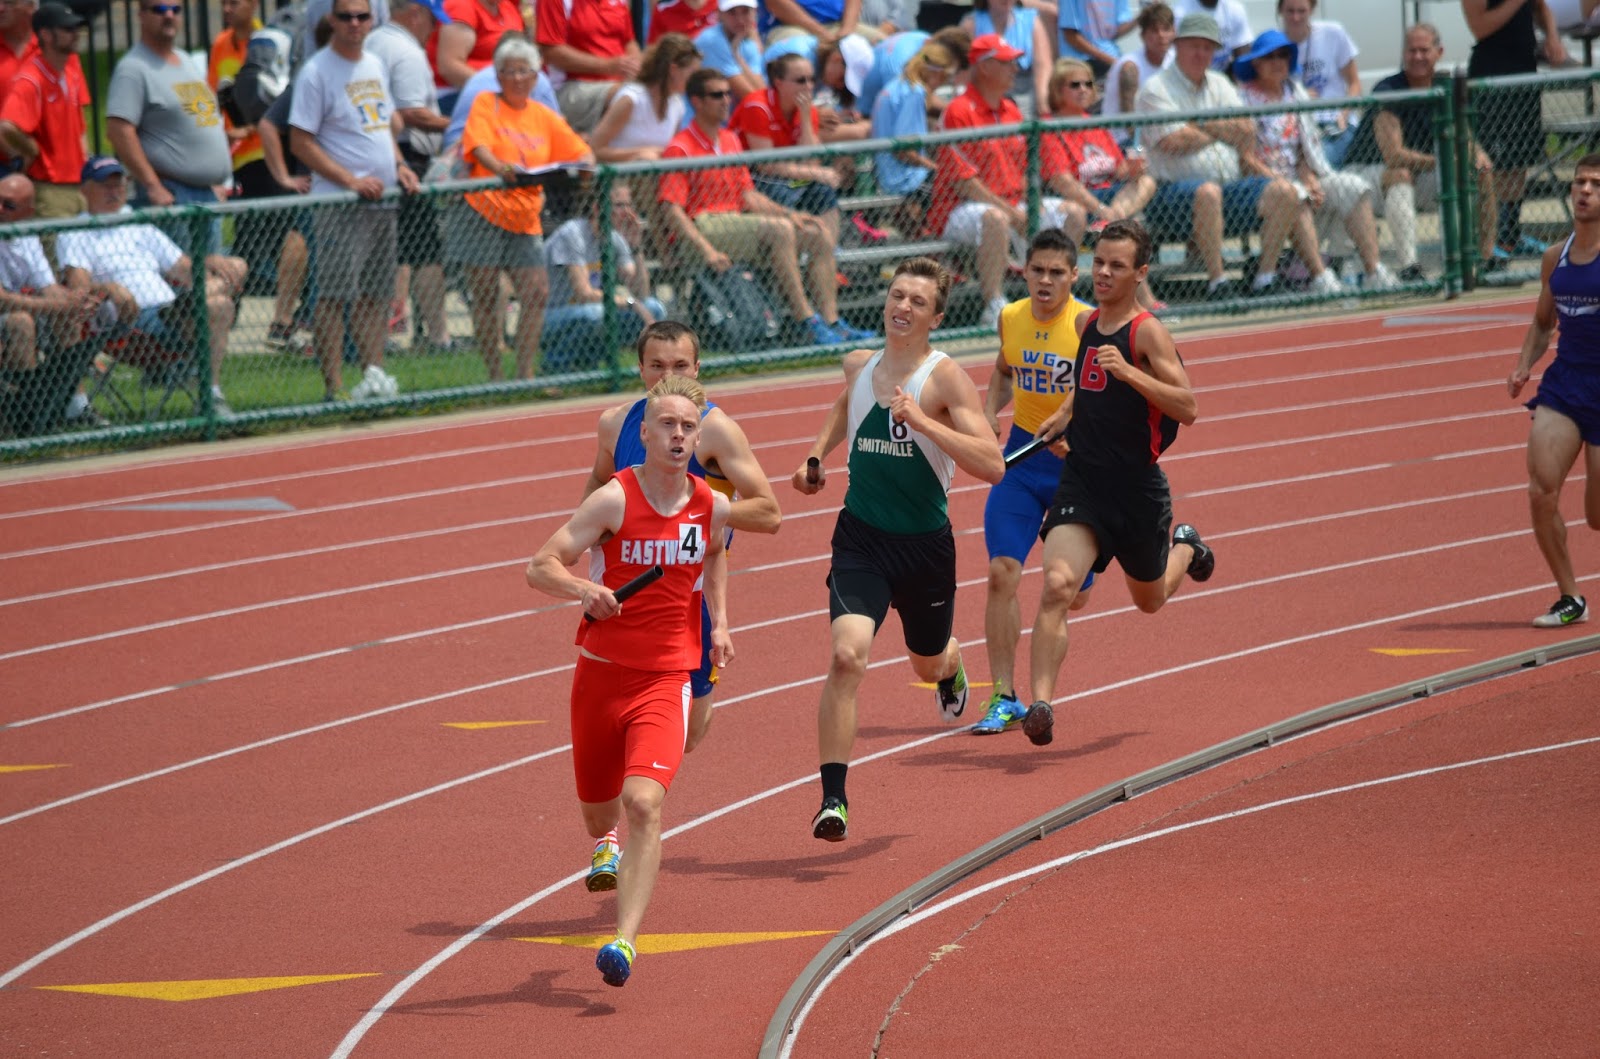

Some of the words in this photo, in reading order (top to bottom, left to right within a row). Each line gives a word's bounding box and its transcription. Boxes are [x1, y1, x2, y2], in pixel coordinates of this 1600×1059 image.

[1055, 360, 1073, 384] 2
[1079, 346, 1107, 392] B
[857, 437, 914, 457] SMITHVILLE
[681, 526, 698, 558] 4
